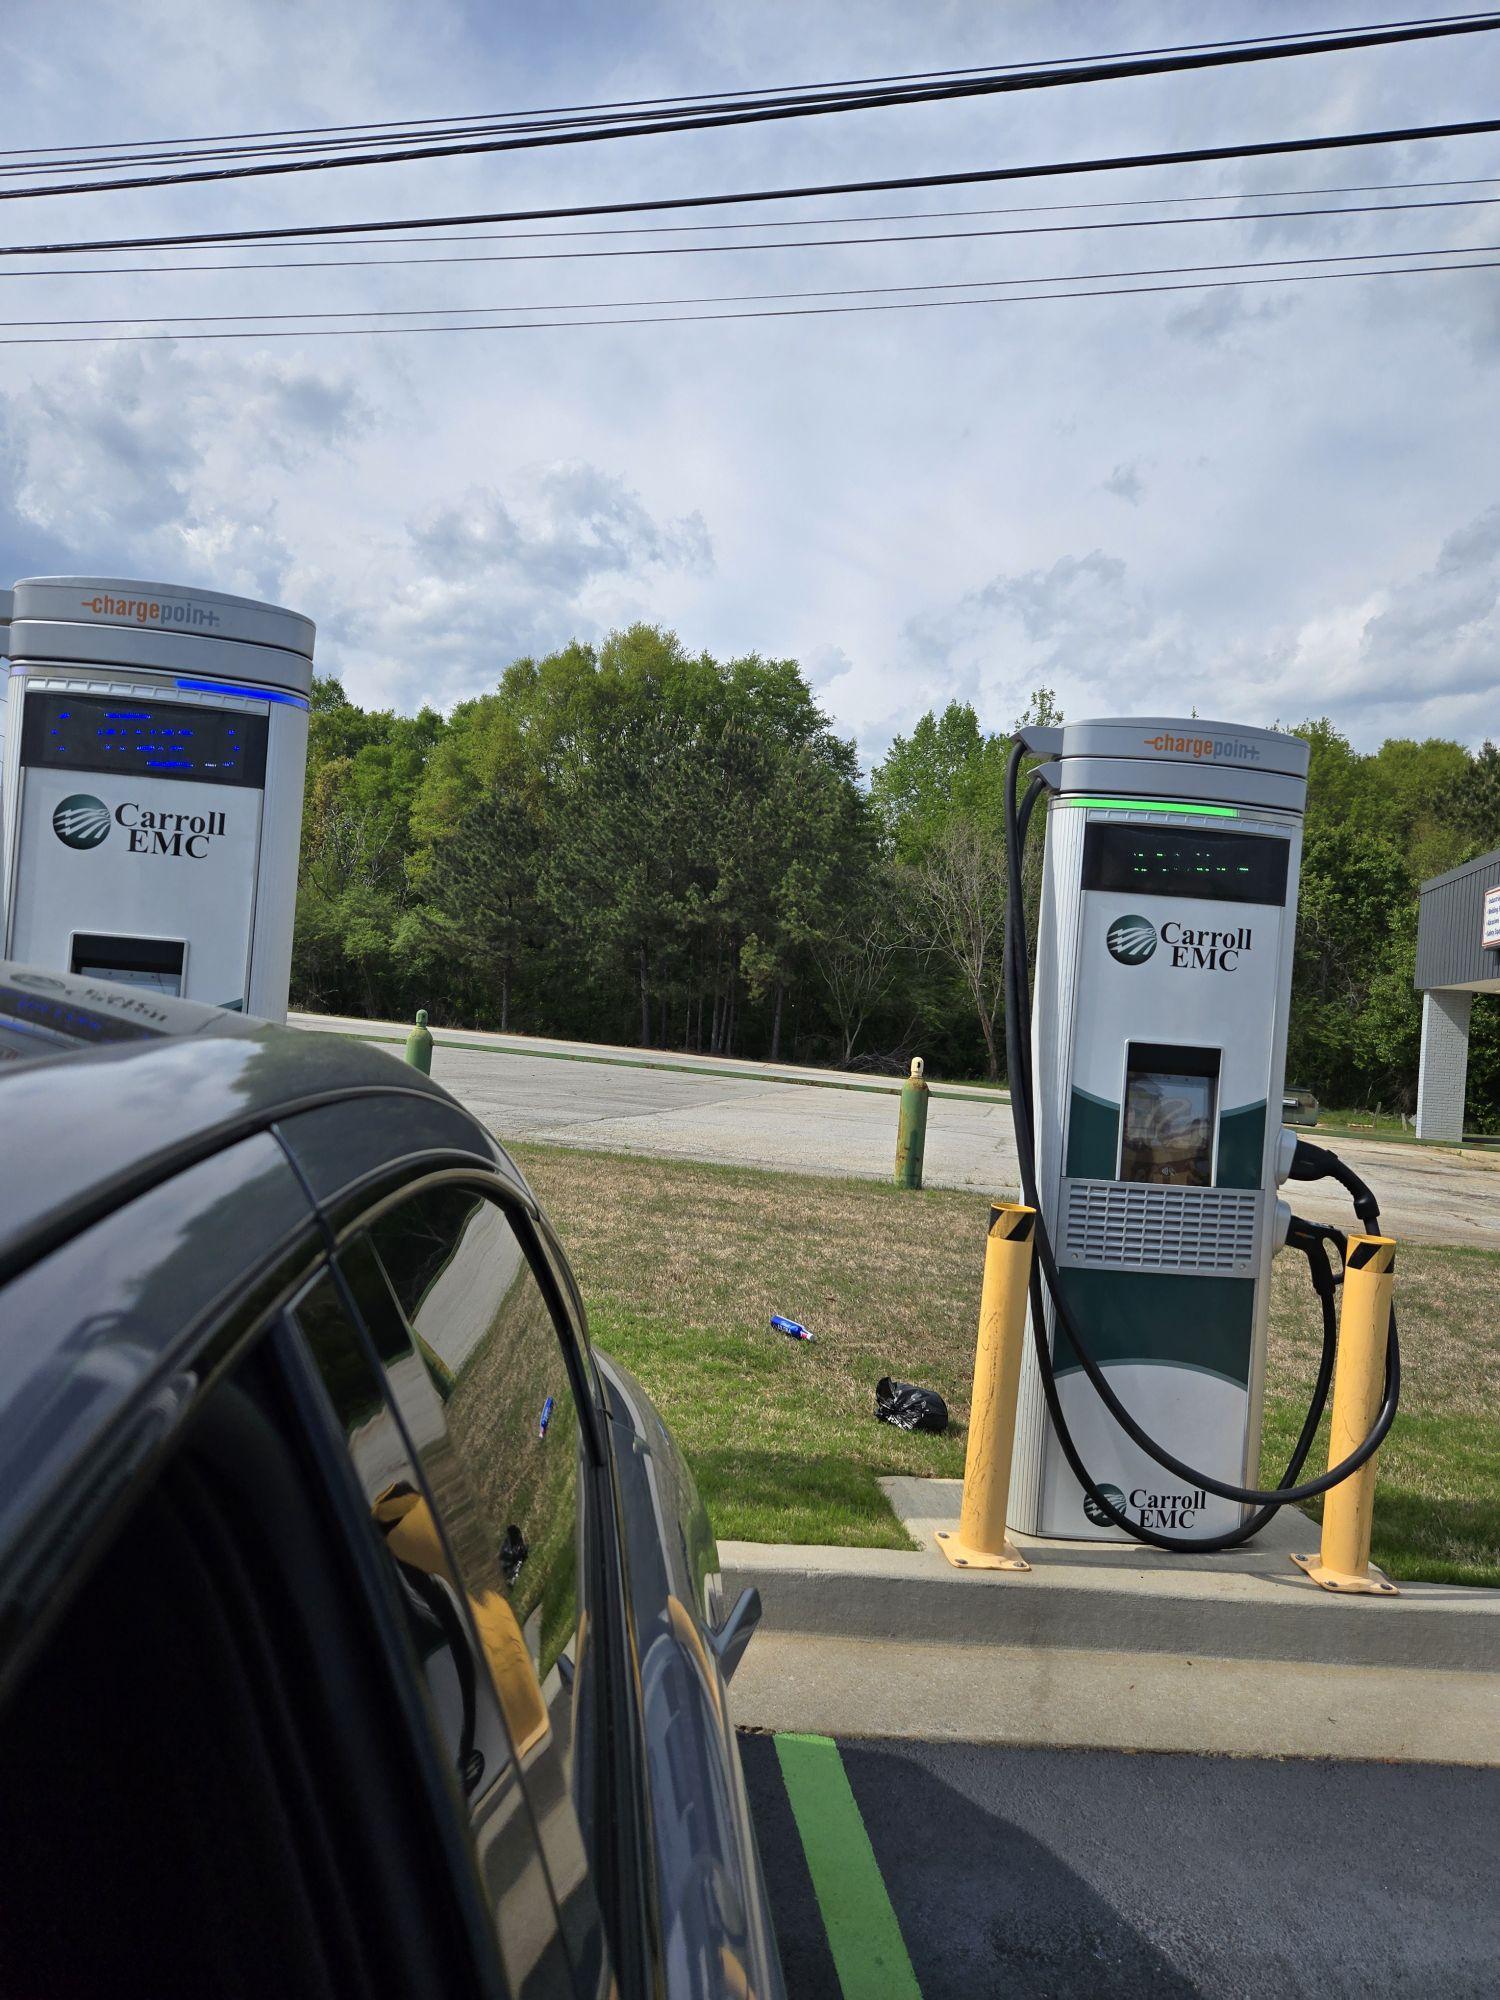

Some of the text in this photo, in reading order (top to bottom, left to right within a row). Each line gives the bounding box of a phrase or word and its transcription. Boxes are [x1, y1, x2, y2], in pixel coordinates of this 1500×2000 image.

[115, 802, 226, 837] Carroll
[127, 828, 211, 859] EMC
[1160, 922, 1252, 950] Carroll
[1170, 945, 1239, 972] EMC
[1129, 1489, 1206, 1510] Carroll
[1139, 1509, 1196, 1529] EMC
